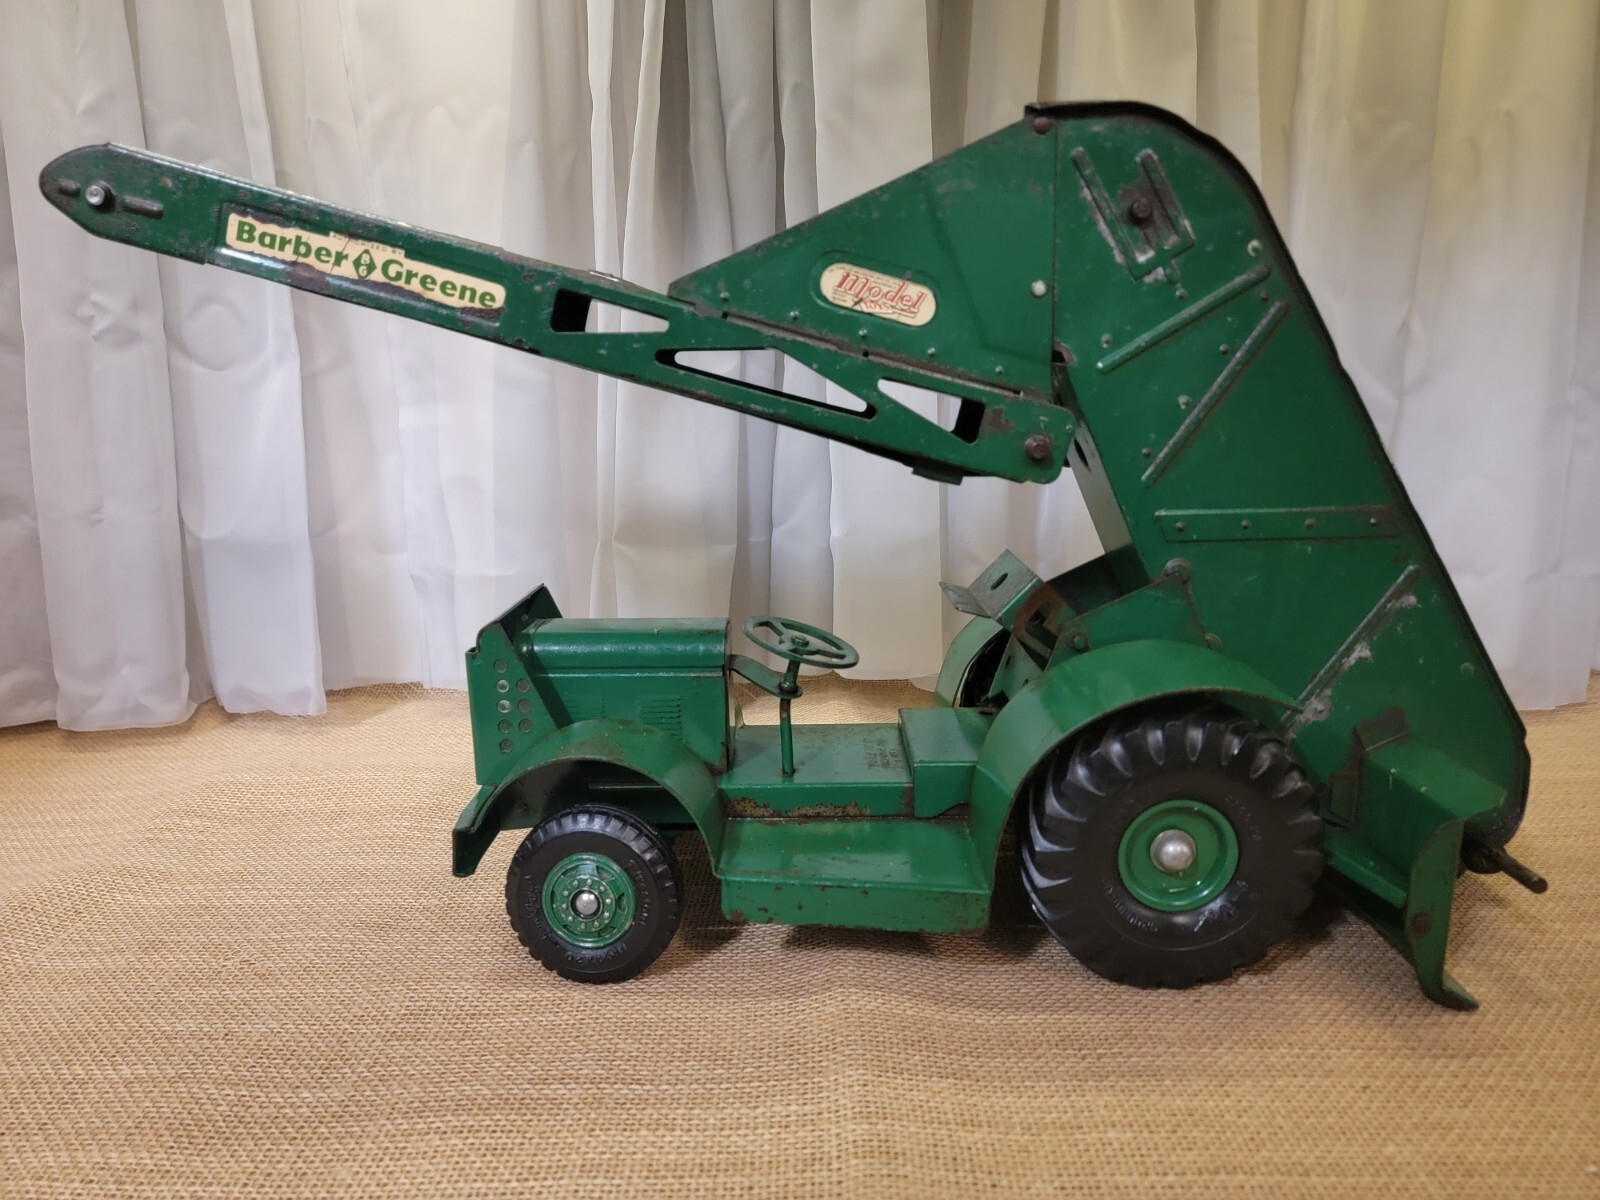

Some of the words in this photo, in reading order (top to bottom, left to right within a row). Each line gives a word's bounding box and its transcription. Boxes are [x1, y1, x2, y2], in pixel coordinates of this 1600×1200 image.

[237, 220, 349, 268] Barber
[381, 258, 497, 308] Greene
[836, 271, 926, 311] Model
